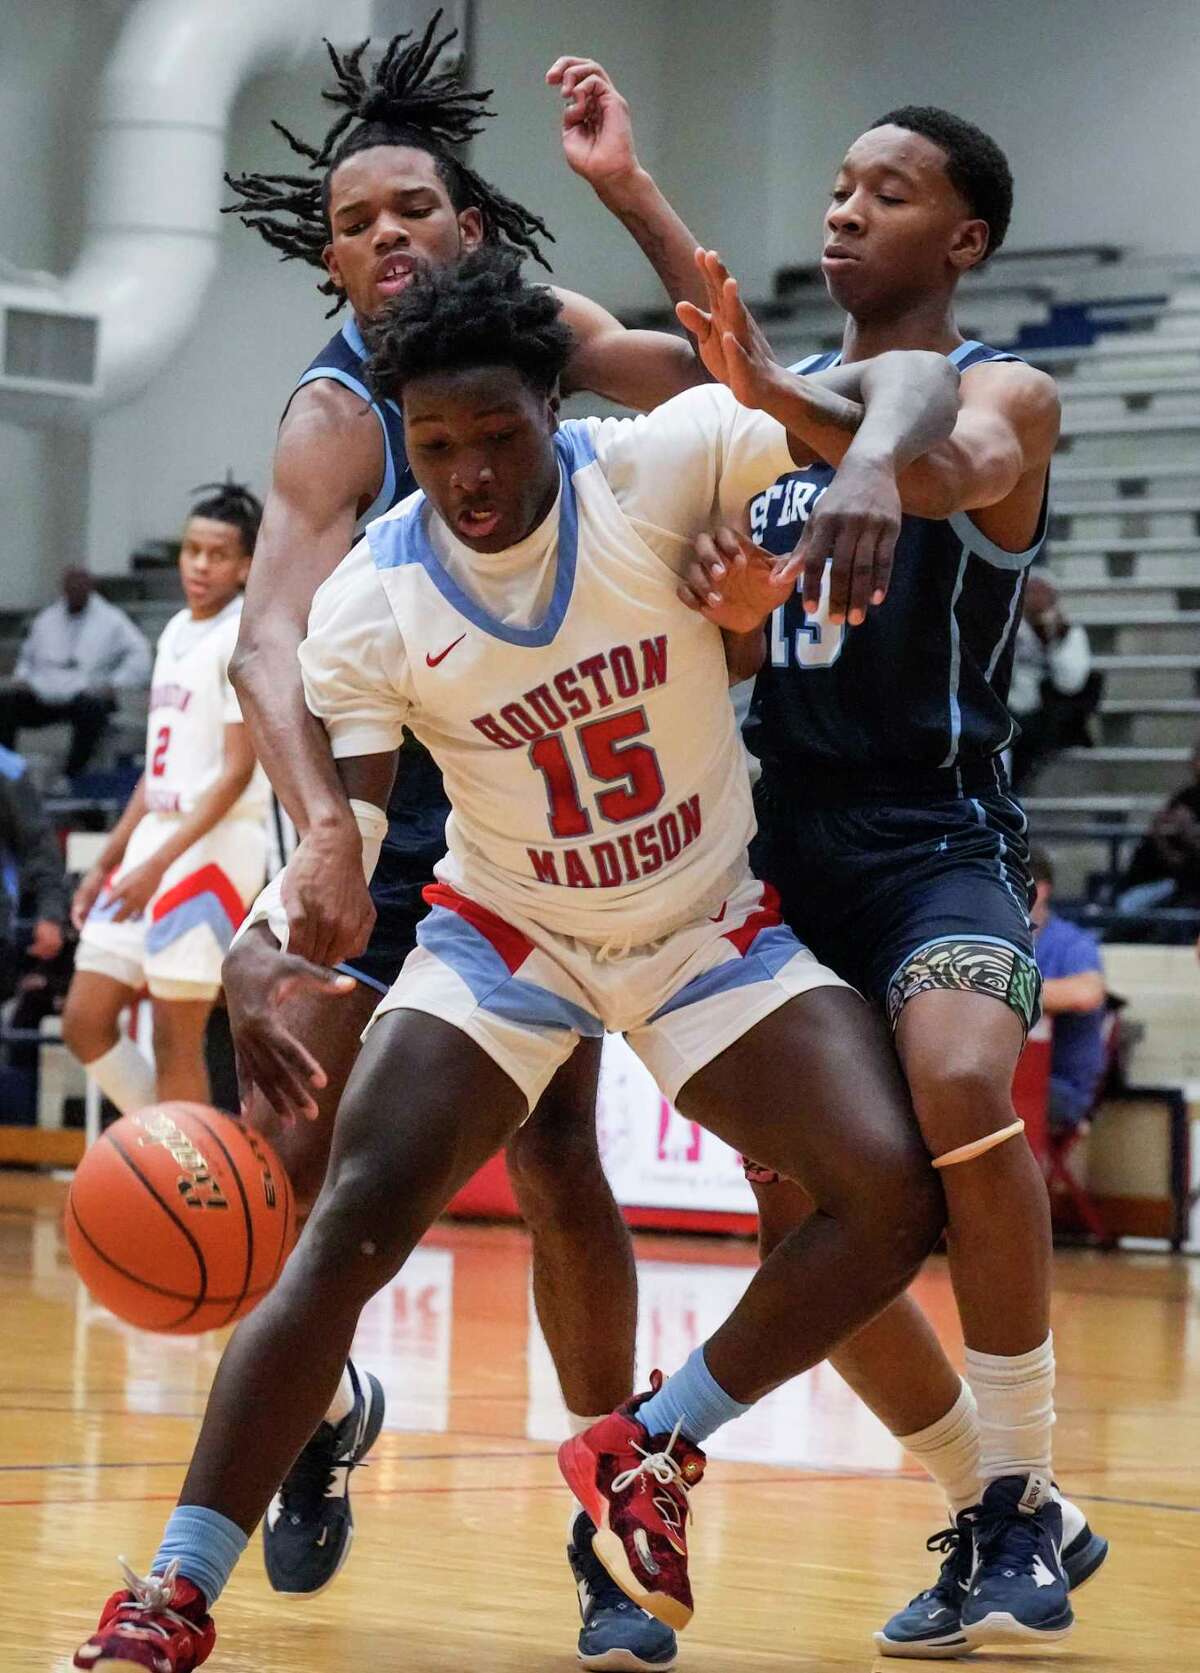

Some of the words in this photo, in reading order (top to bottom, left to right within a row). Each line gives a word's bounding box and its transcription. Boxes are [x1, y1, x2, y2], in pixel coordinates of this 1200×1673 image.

[470, 635, 668, 749] HOUSTON
[152, 726, 171, 777] 2
[527, 704, 666, 839] 15
[526, 793, 701, 888] MADISON
